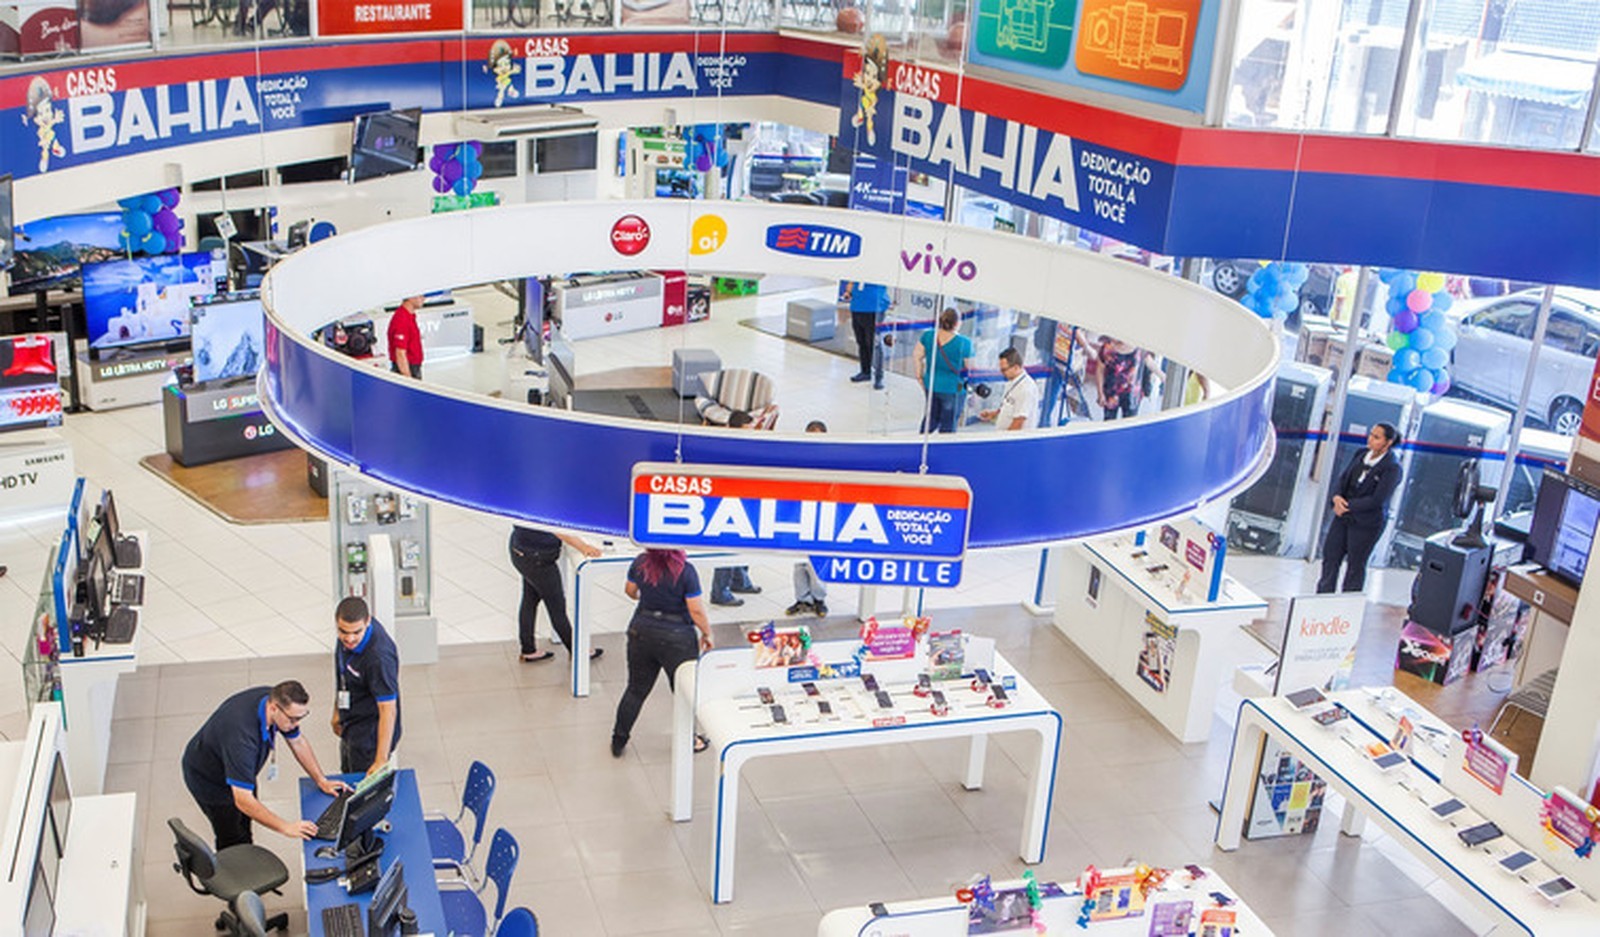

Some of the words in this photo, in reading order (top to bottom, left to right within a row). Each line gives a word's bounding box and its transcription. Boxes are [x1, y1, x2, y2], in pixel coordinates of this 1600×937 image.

[354, 3, 432, 23] RESTAURANTE
[525, 38, 570, 57] CASAS
[525, 52, 699, 98] BAHIA
[731, 67, 739, 77] A
[895, 65, 941, 100] CASAS
[66, 69, 117, 97] CASAS
[293, 92, 302, 103] A
[68, 76, 261, 154] BAHIA
[891, 88, 1080, 213] BAHIA
[1080, 150, 1151, 185] DEDICAÇÃO
[1088, 174, 1124, 201] TOTAL
[1126, 187, 1136, 205] A
[1093, 198, 1126, 224] VOCÊ
[612, 230, 643, 243] Claro
[699, 230, 719, 250] oi
[809, 231, 852, 255] TIM
[900, 243, 977, 281] vivo
[213, 398, 228, 411] LG
[258, 423, 275, 437] LG
[650, 475, 713, 495] CASAS
[647, 493, 889, 545] BAHIA
[886, 509, 952, 525] DEDICAÇÃO
[893, 521, 930, 534] TOTAL
[932, 524, 943, 534] A
[901, 533, 933, 546] VOCÊ
[830, 558, 951, 585] MOBILE
[1299, 616, 1351, 637] kindle
